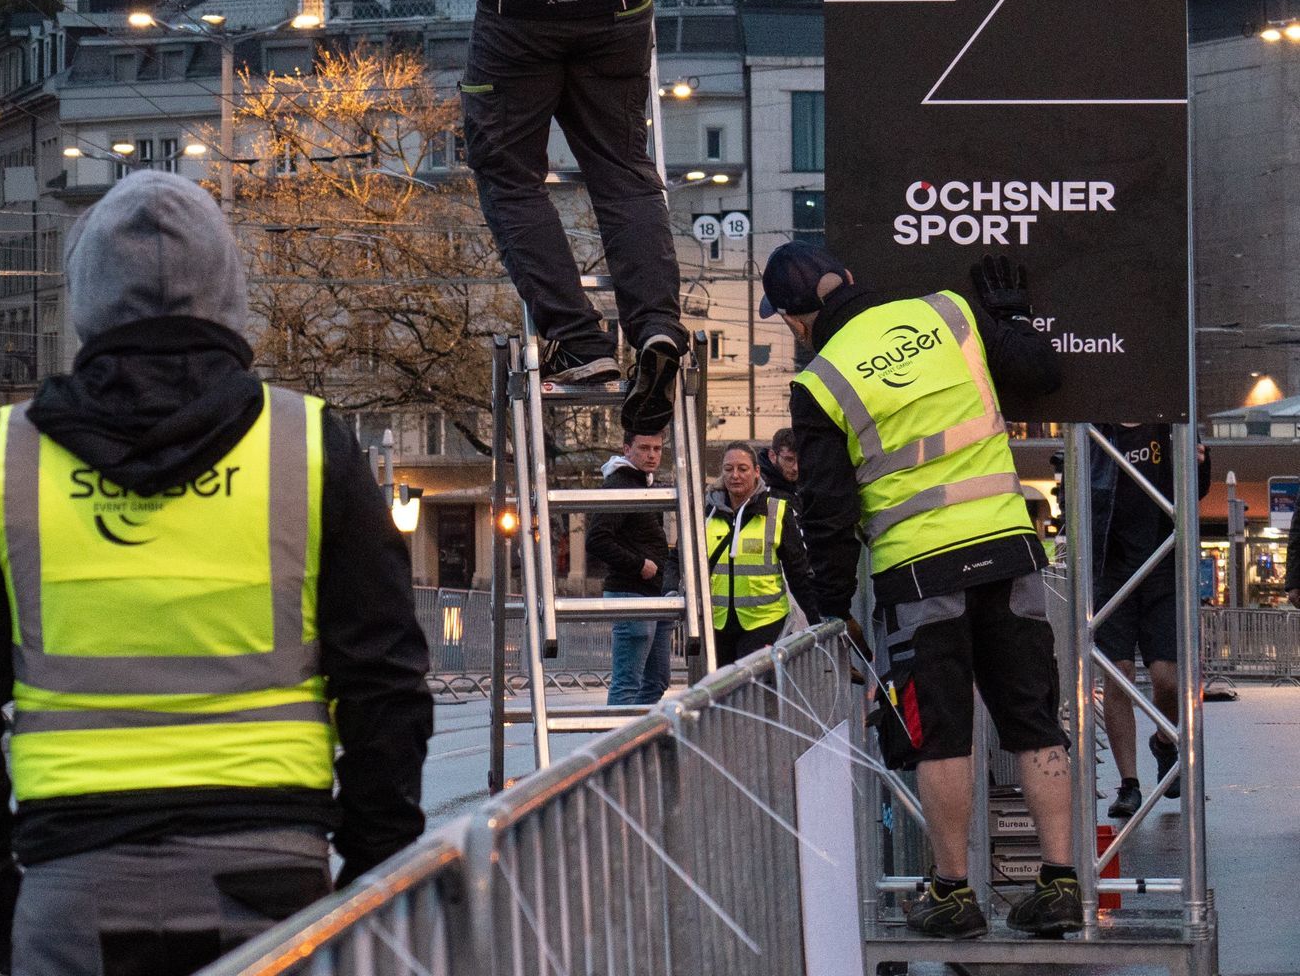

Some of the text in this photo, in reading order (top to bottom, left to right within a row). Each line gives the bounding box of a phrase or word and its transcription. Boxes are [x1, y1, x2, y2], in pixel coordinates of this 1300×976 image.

[905, 180, 1116, 213] OCHSNER
[699, 223, 715, 237] 18
[729, 219, 744, 233] 18
[893, 214, 1037, 246] SPORT
[856, 327, 943, 379] sauser
[94, 502, 128, 512] EVENT
[998, 820, 1029, 828] Bureau
[1001, 865, 1032, 873] Transfo
